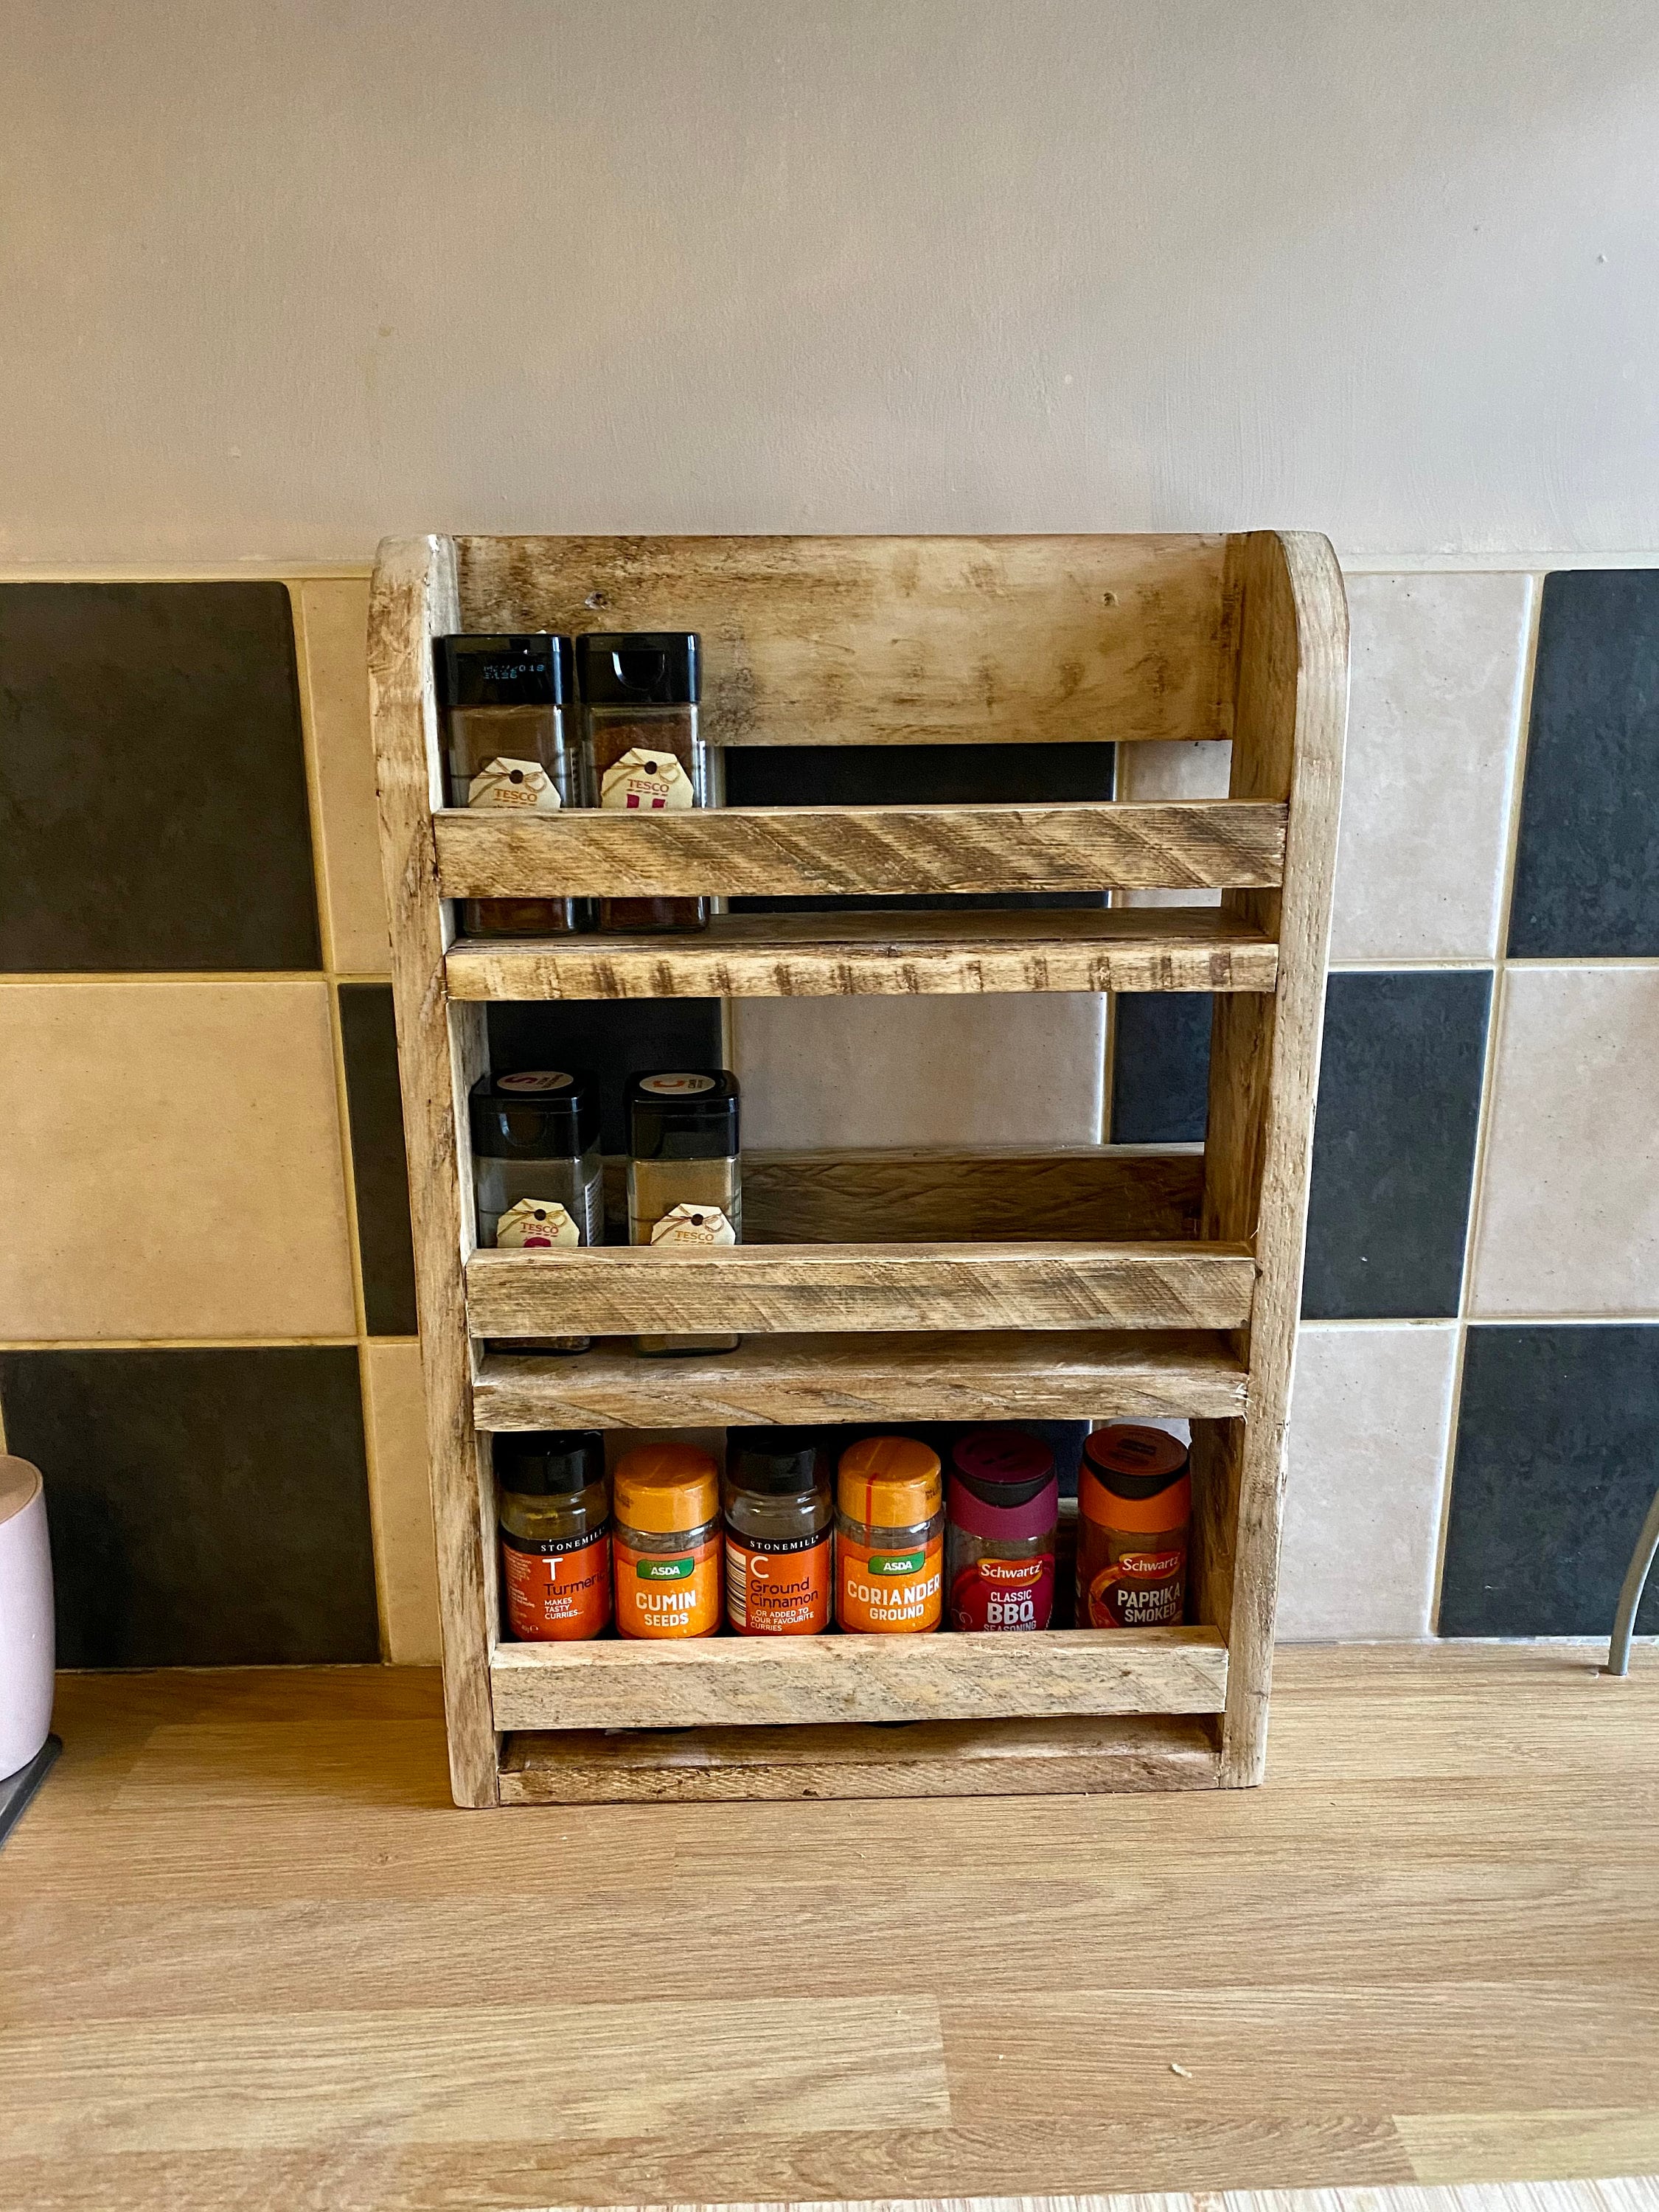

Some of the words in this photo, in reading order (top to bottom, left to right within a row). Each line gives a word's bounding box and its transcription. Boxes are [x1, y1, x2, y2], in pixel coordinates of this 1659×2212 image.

[627, 779, 669, 793] TESCO
[493, 788, 538, 802] TESCO
[521, 1222, 559, 1234] TESCO
[675, 1230, 714, 1242] TESCO
[750, 1537, 816, 1551] STONEMILL
[542, 1557, 563, 1581] T
[650, 1565, 681, 1576] ASDA
[750, 1555, 769, 1579] C
[883, 1560, 913, 1571] ASDA
[1122, 1557, 1179, 1571] Schwartz
[981, 1564, 1040, 1579] Schwartz
[750, 1576, 810, 1595] Ground
[847, 1573, 940, 1606] CORIANDER
[544, 1596, 573, 1606] MAKES
[636, 1589, 697, 1612] CUMIN
[750, 1590, 818, 1609] Cinnamon
[990, 1589, 1032, 1602] CLASSIC
[1117, 1582, 1180, 1608] PAPRIKA
[545, 1604, 570, 1613] TASTY
[545, 1609, 578, 1620] CURRIES
[770, 1610, 796, 1618] ADDED
[869, 1604, 925, 1621] GROUND
[987, 1600, 1034, 1625] BBQ
[1124, 1601, 1176, 1623] SMOKED
[644, 1612, 689, 1627] SEEDS
[750, 1614, 771, 1624] YOUR
[773, 1611, 815, 1625] FAVOURITE
[750, 1622, 782, 1632] CURRIES
